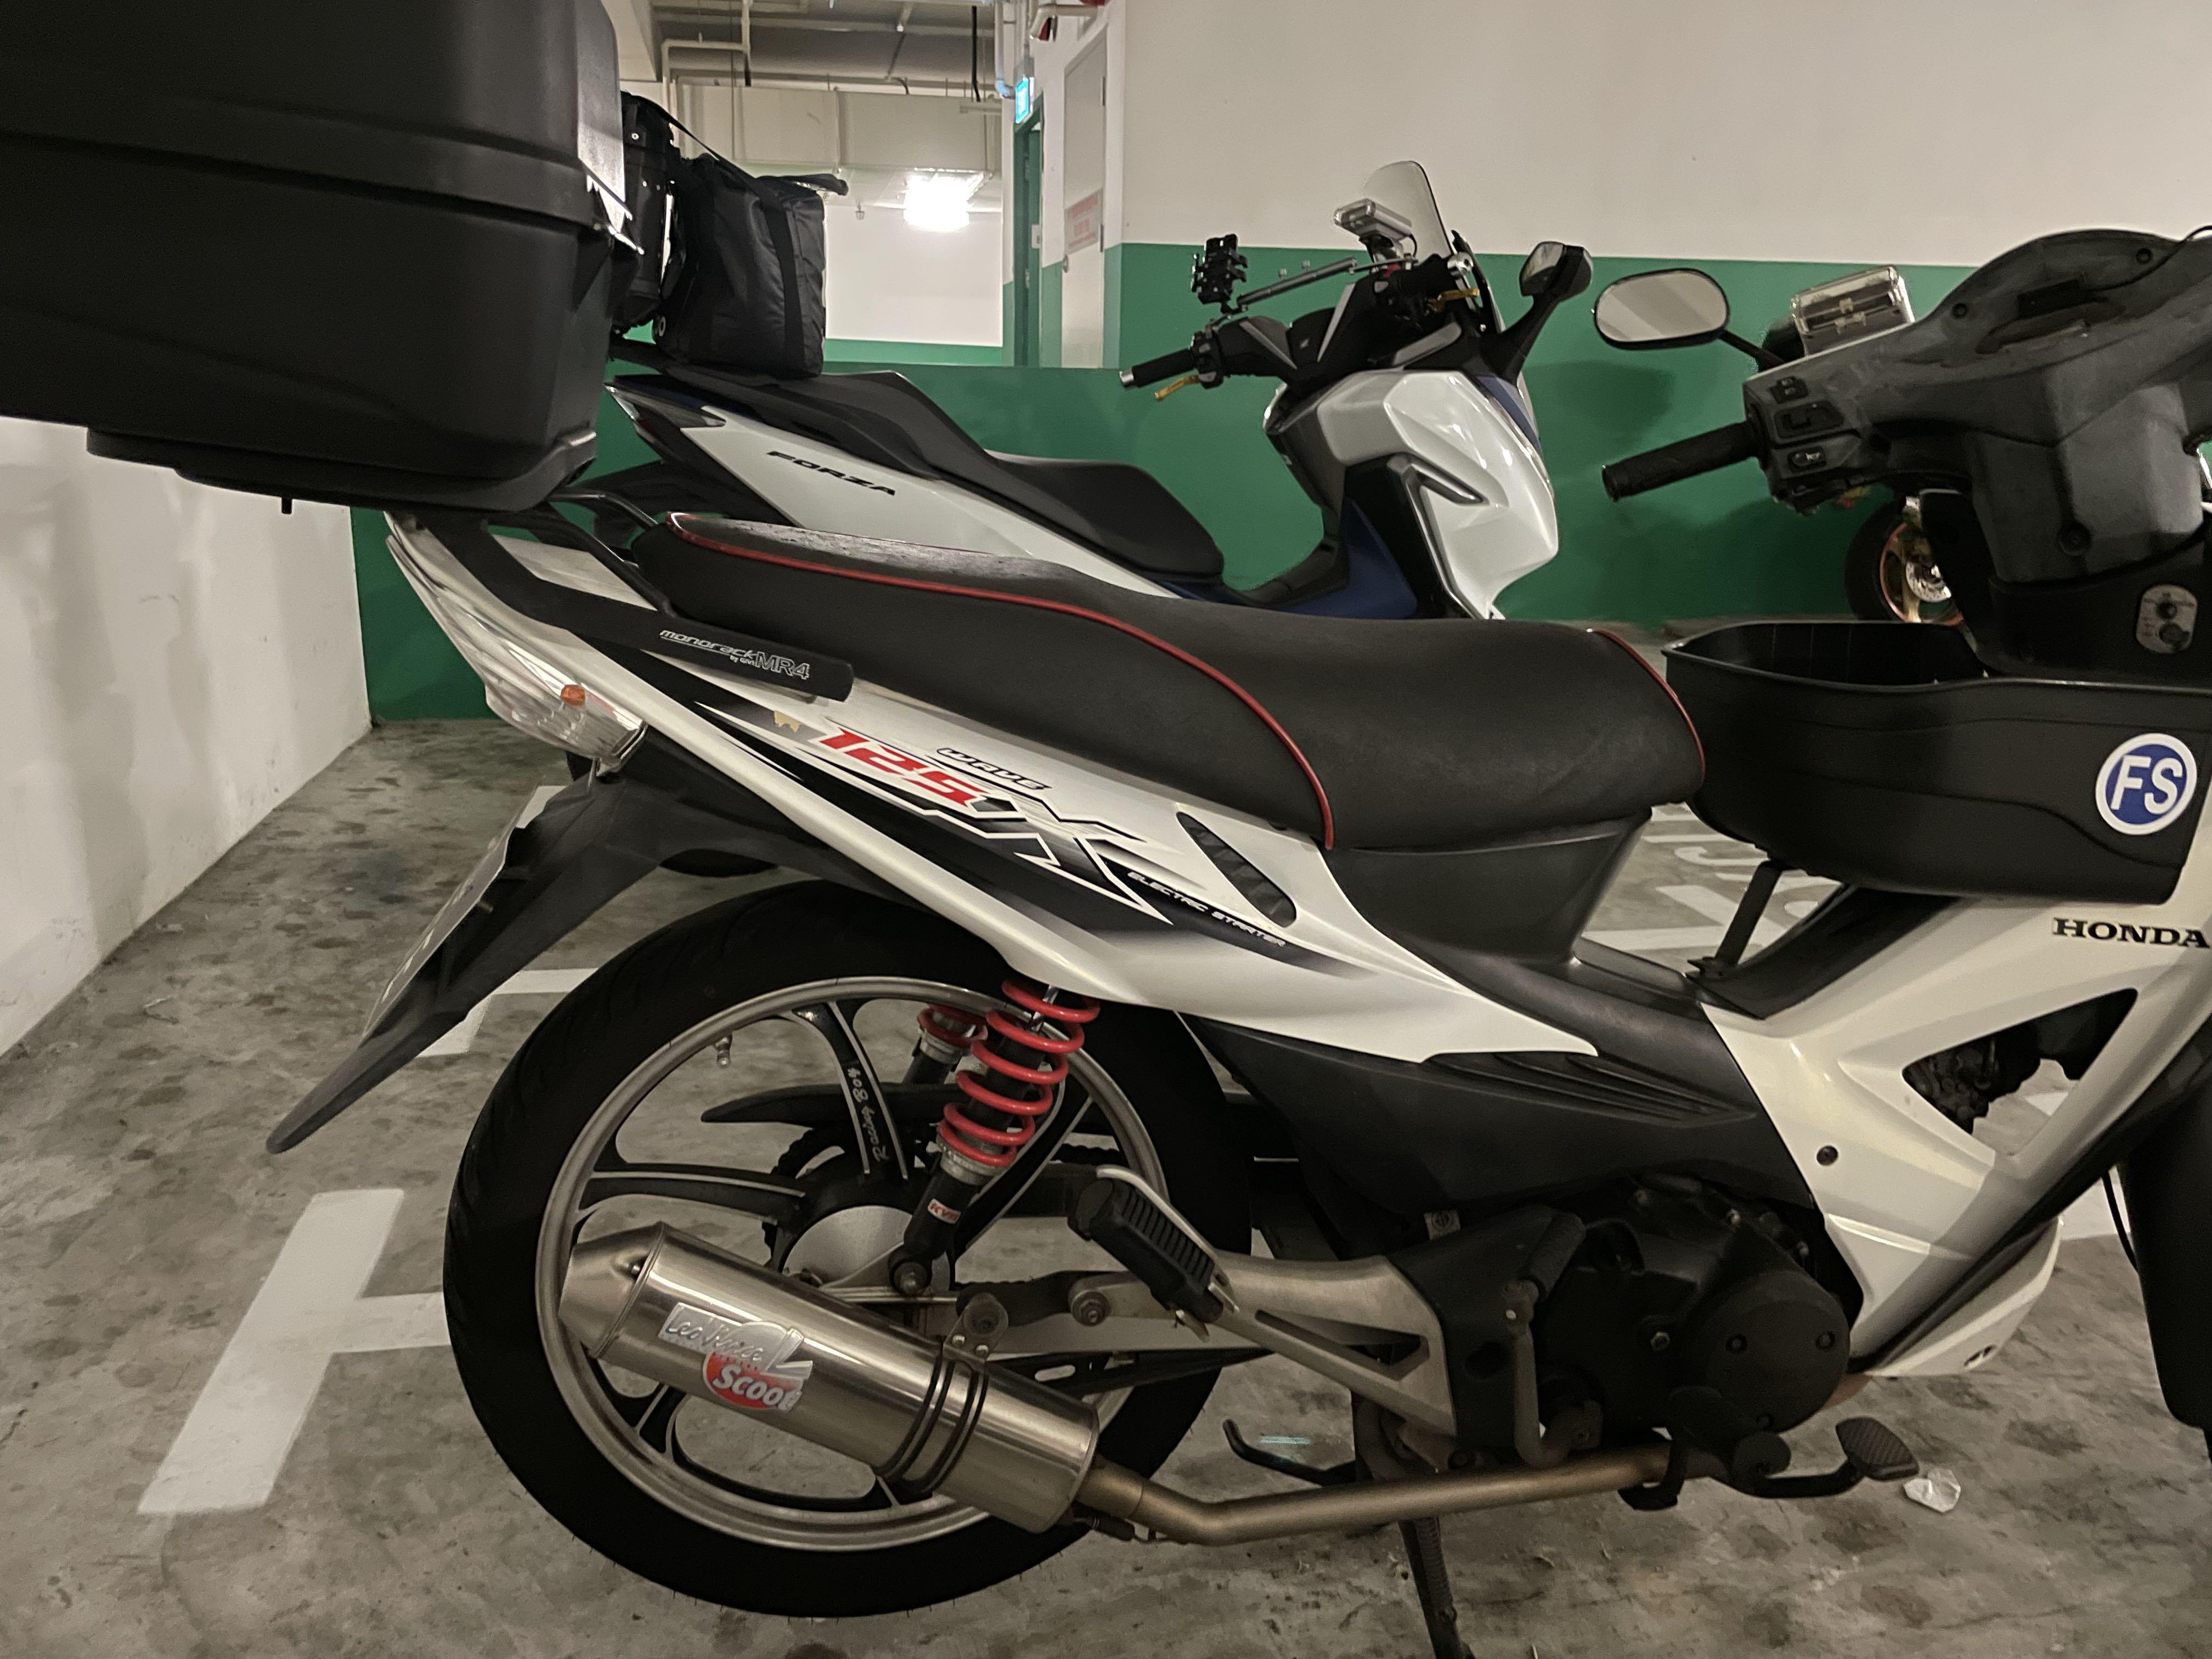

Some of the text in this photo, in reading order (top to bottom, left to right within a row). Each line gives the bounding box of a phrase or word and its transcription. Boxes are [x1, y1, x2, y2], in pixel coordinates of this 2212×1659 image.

[768, 450, 895, 495] FORZA
[659, 630, 810, 680] monorack MR4
[2111, 754, 2182, 815] FS
[1127, 871, 1286, 947] ELECTRIC STARTER
[2053, 917, 2211, 949] HONDA
